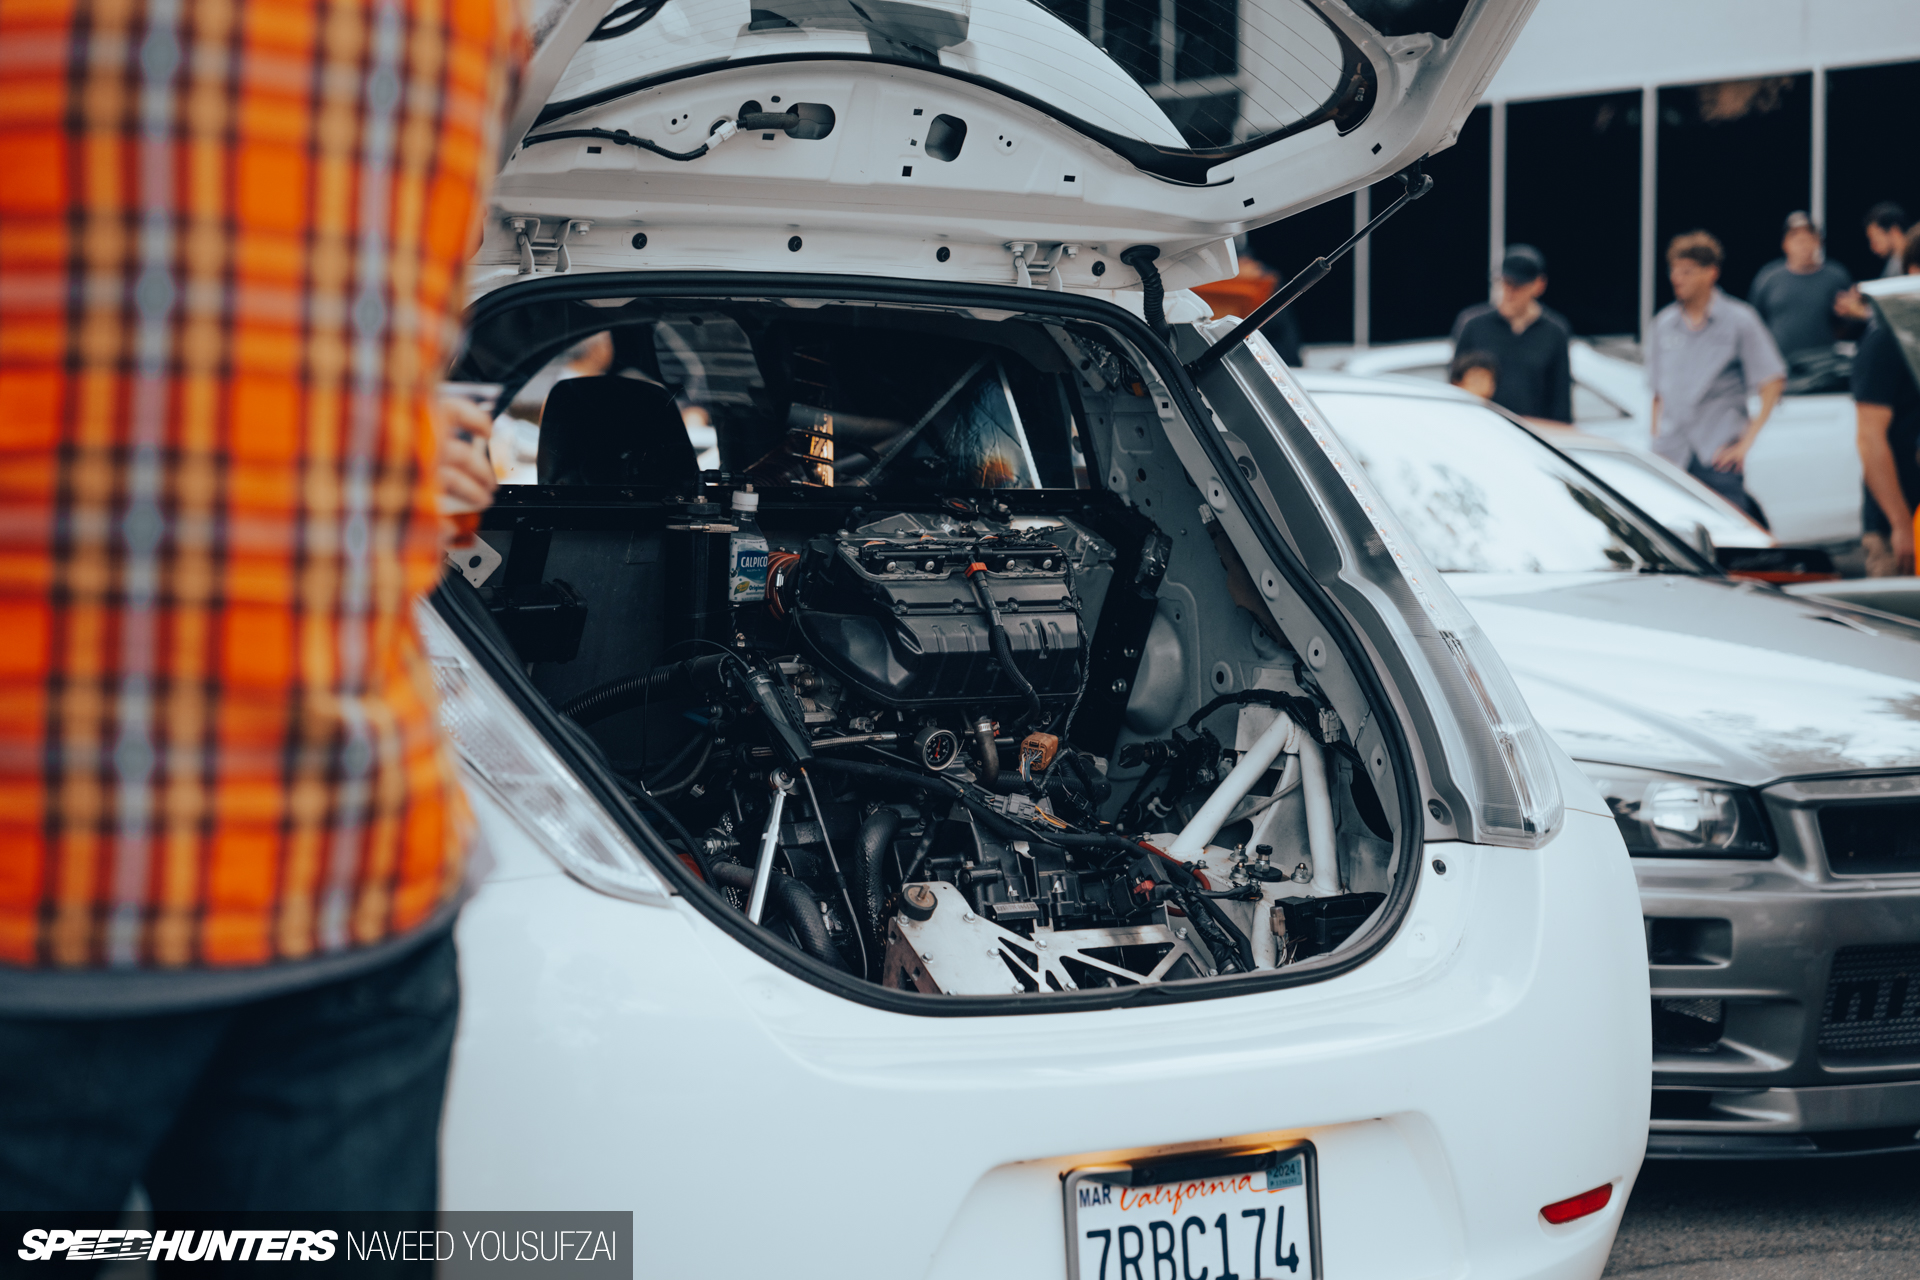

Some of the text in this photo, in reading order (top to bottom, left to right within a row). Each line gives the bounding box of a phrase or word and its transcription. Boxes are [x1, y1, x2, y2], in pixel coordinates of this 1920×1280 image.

[741, 556, 768, 568] CALPICO
[1273, 1163, 1296, 1178] 2024
[1079, 1186, 1112, 1208] MAR
[1119, 1174, 1268, 1215] California
[1086, 1205, 1299, 1280] 7RBC174
